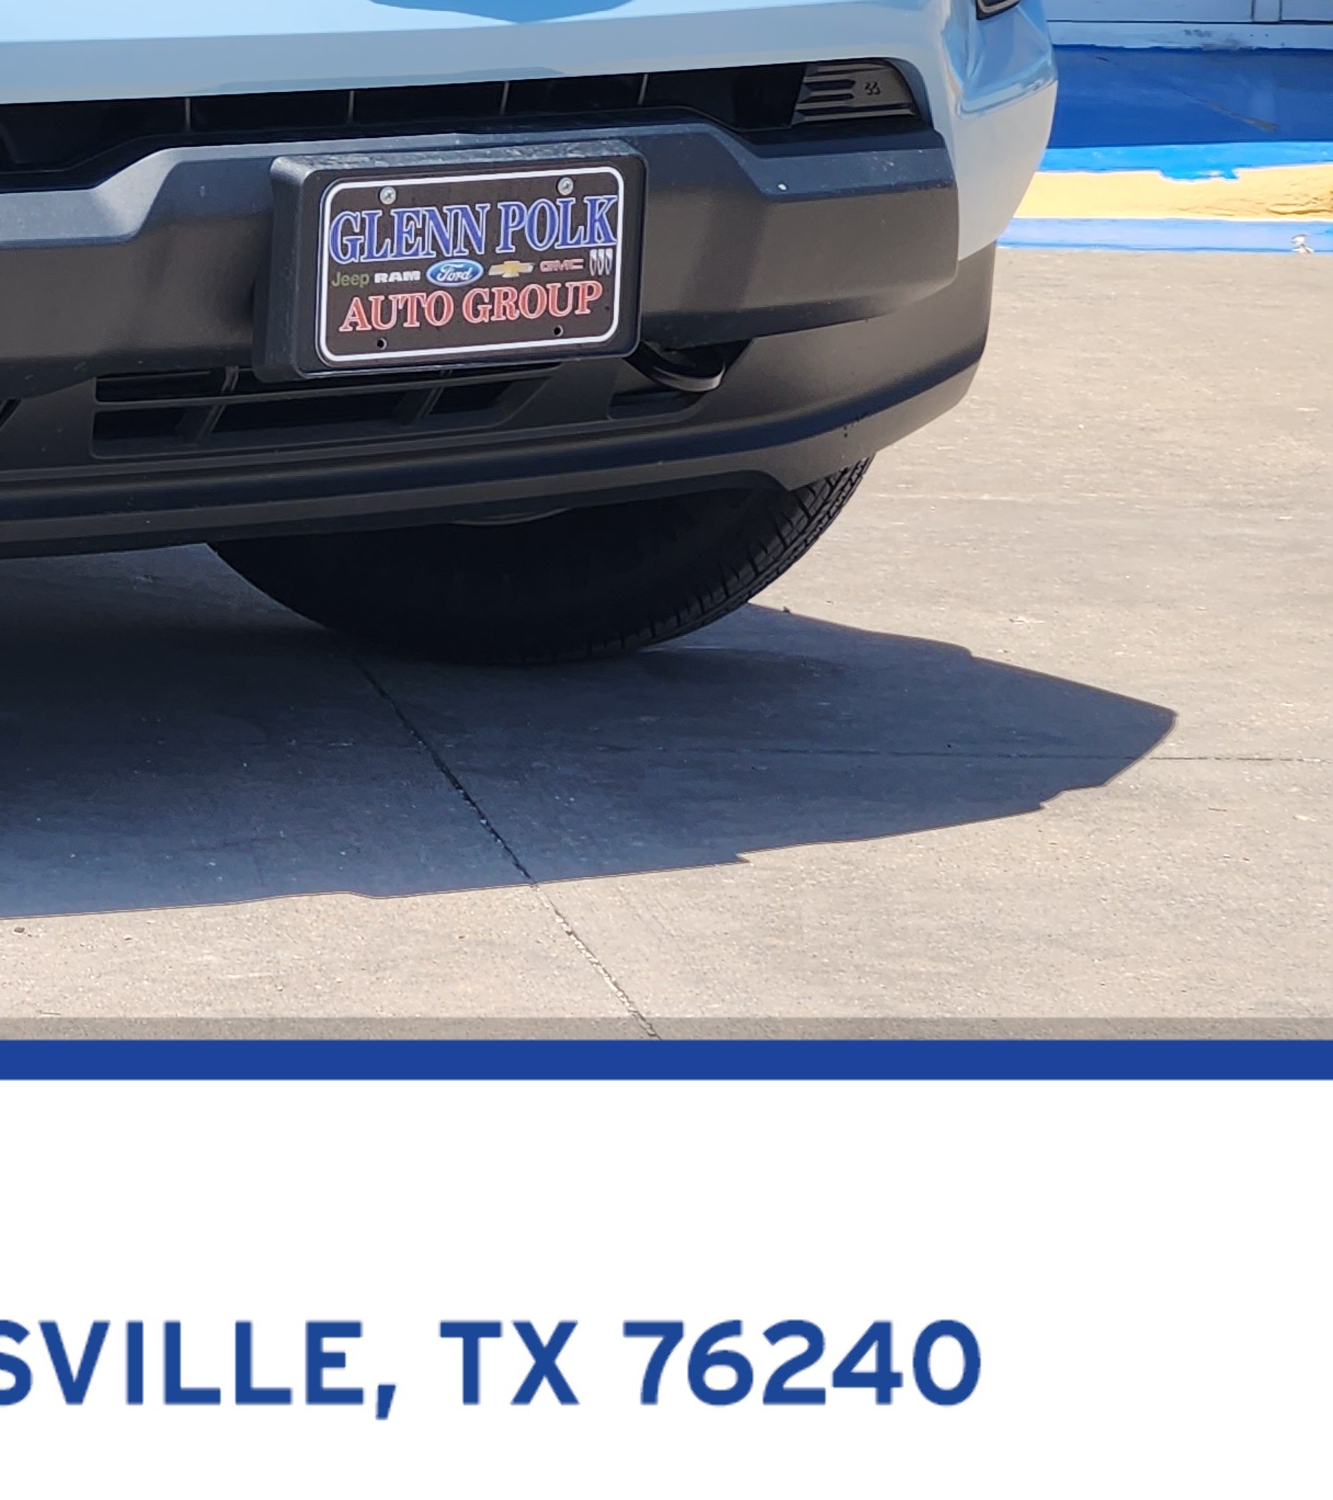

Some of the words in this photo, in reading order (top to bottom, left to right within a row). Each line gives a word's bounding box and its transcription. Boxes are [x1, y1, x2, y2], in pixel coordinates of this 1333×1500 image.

[330, 203, 491, 264] GLENN
[495, 194, 619, 254] POLK
[331, 271, 370, 288] Jeep
[374, 270, 421, 284] RAM
[435, 263, 472, 283] Ford
[540, 257, 584, 272] GMC
[339, 290, 455, 332] AUTO
[462, 279, 603, 324] GROUP
